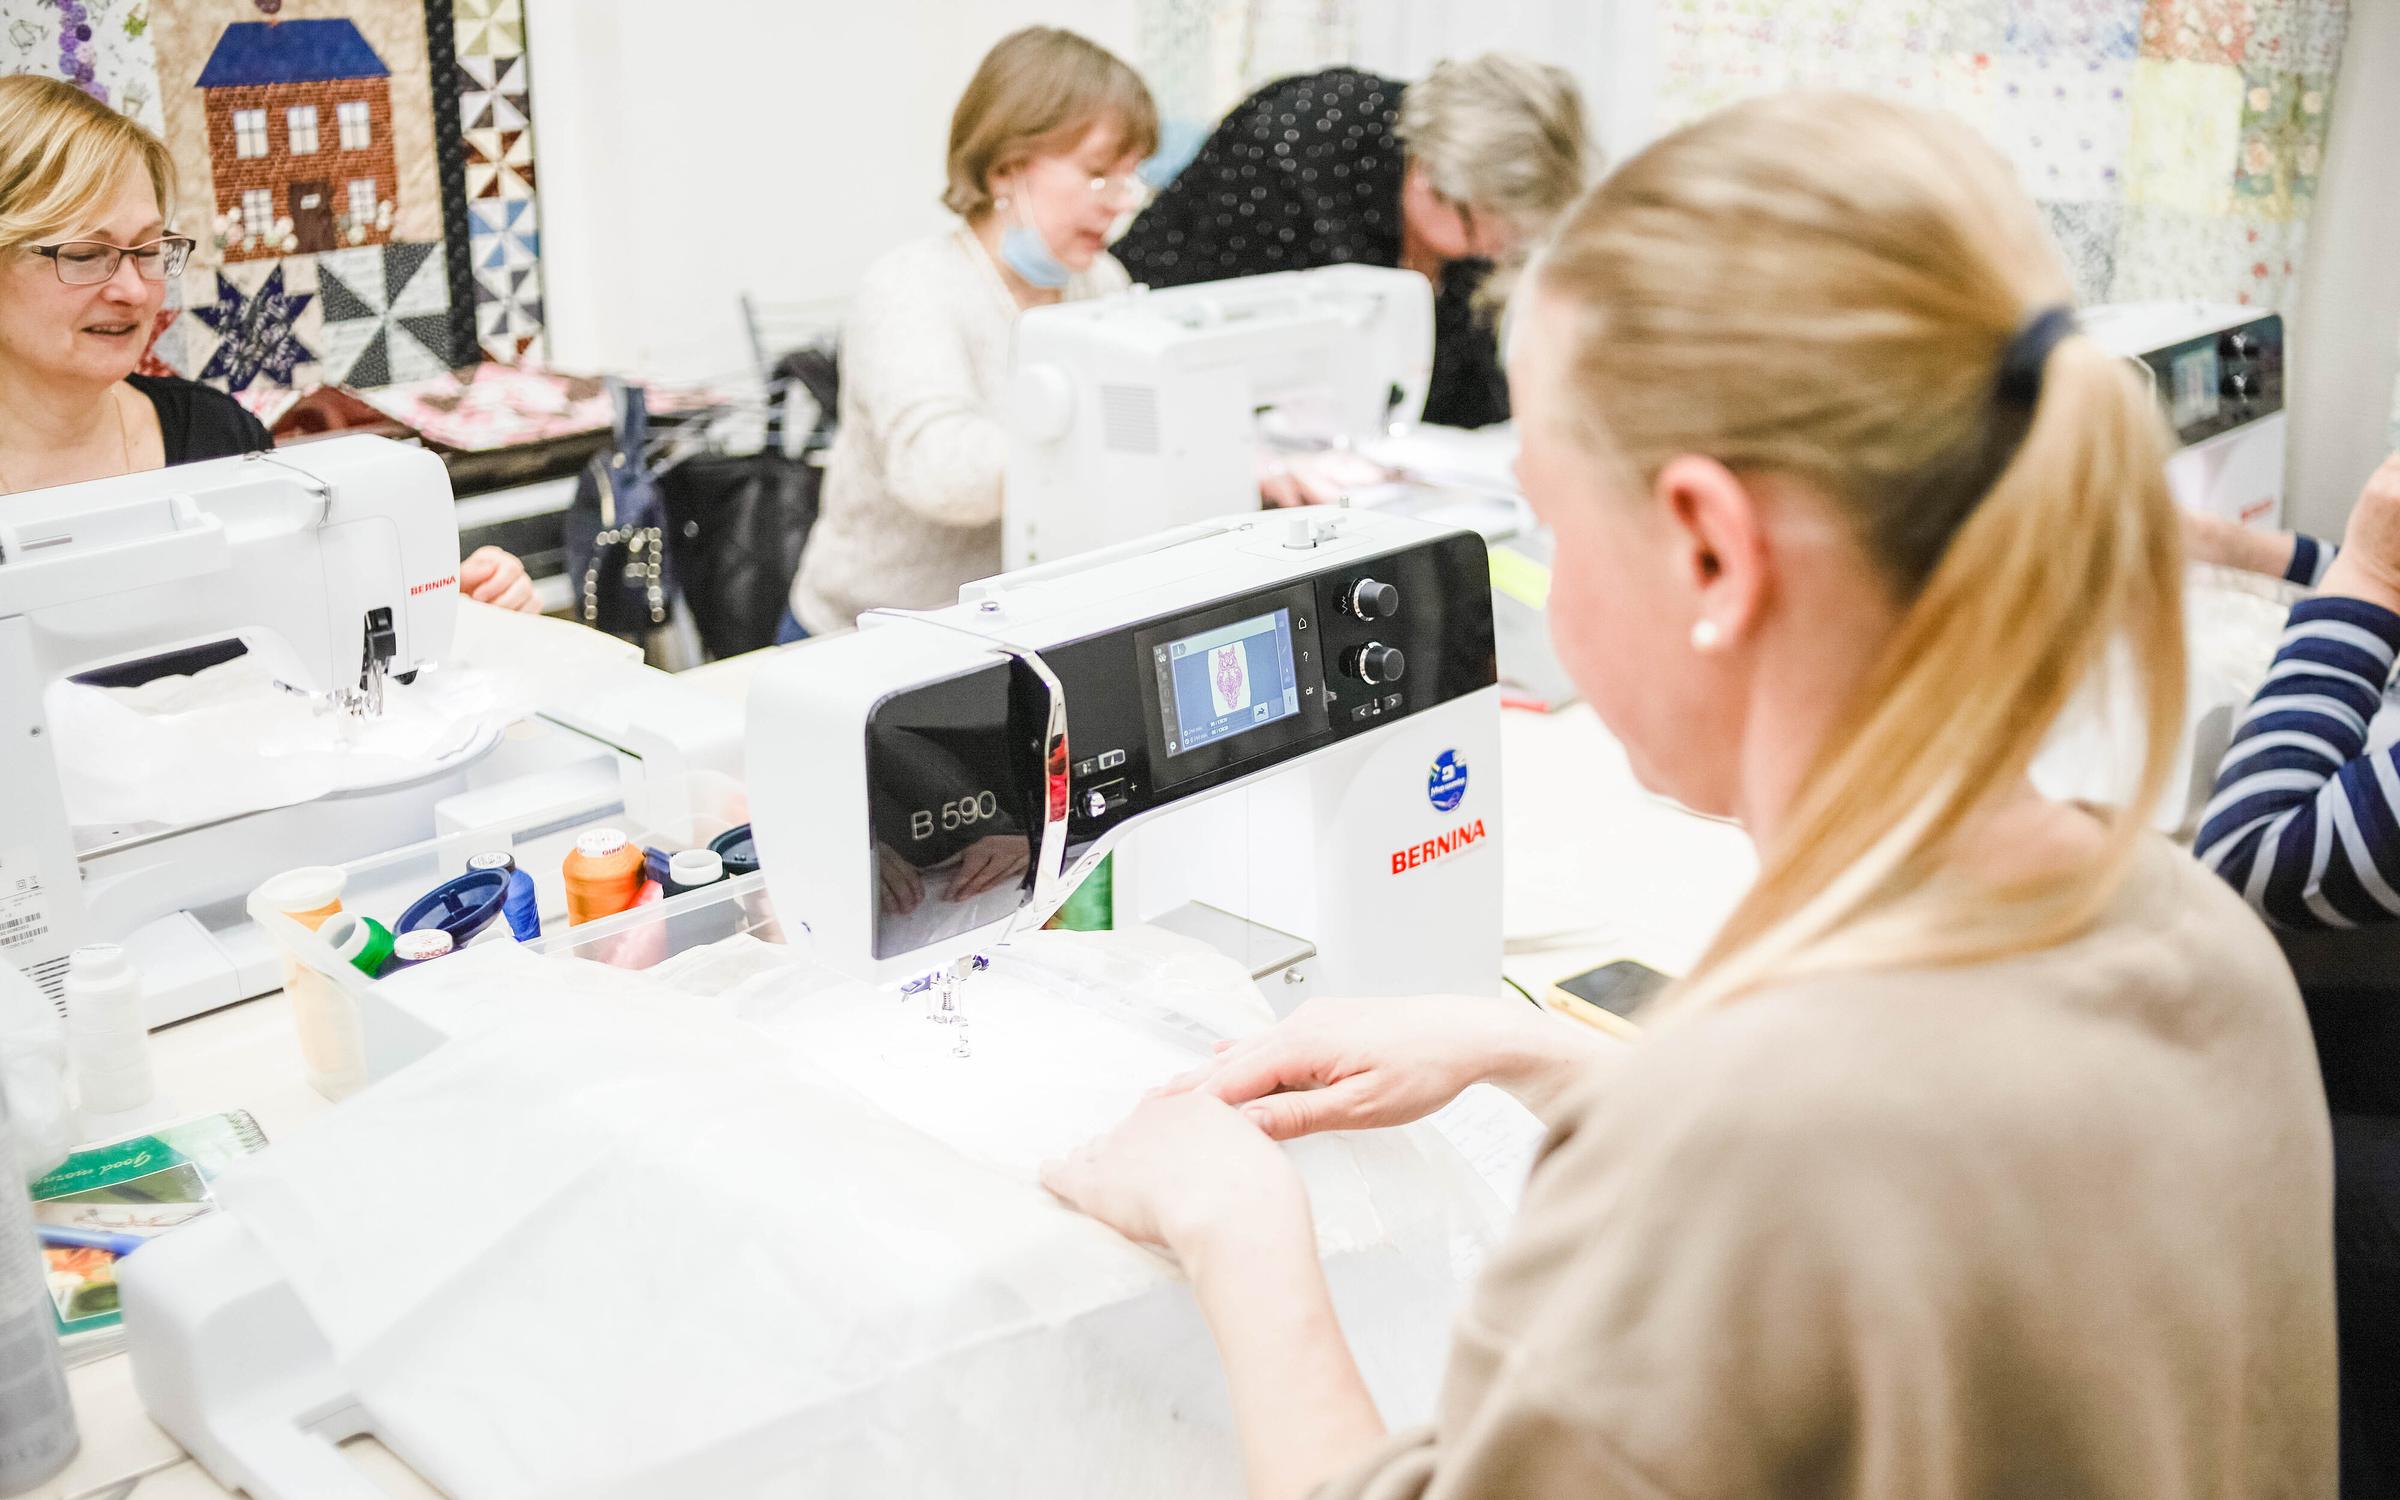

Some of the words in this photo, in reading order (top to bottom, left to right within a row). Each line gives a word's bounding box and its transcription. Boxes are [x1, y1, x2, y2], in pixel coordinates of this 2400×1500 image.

[411, 576, 456, 595] BERNINA
[911, 810, 935, 840] B
[941, 790, 997, 830] 590
[1392, 818, 1485, 875] BERNINA
[98, 1151, 152, 1175] Good
